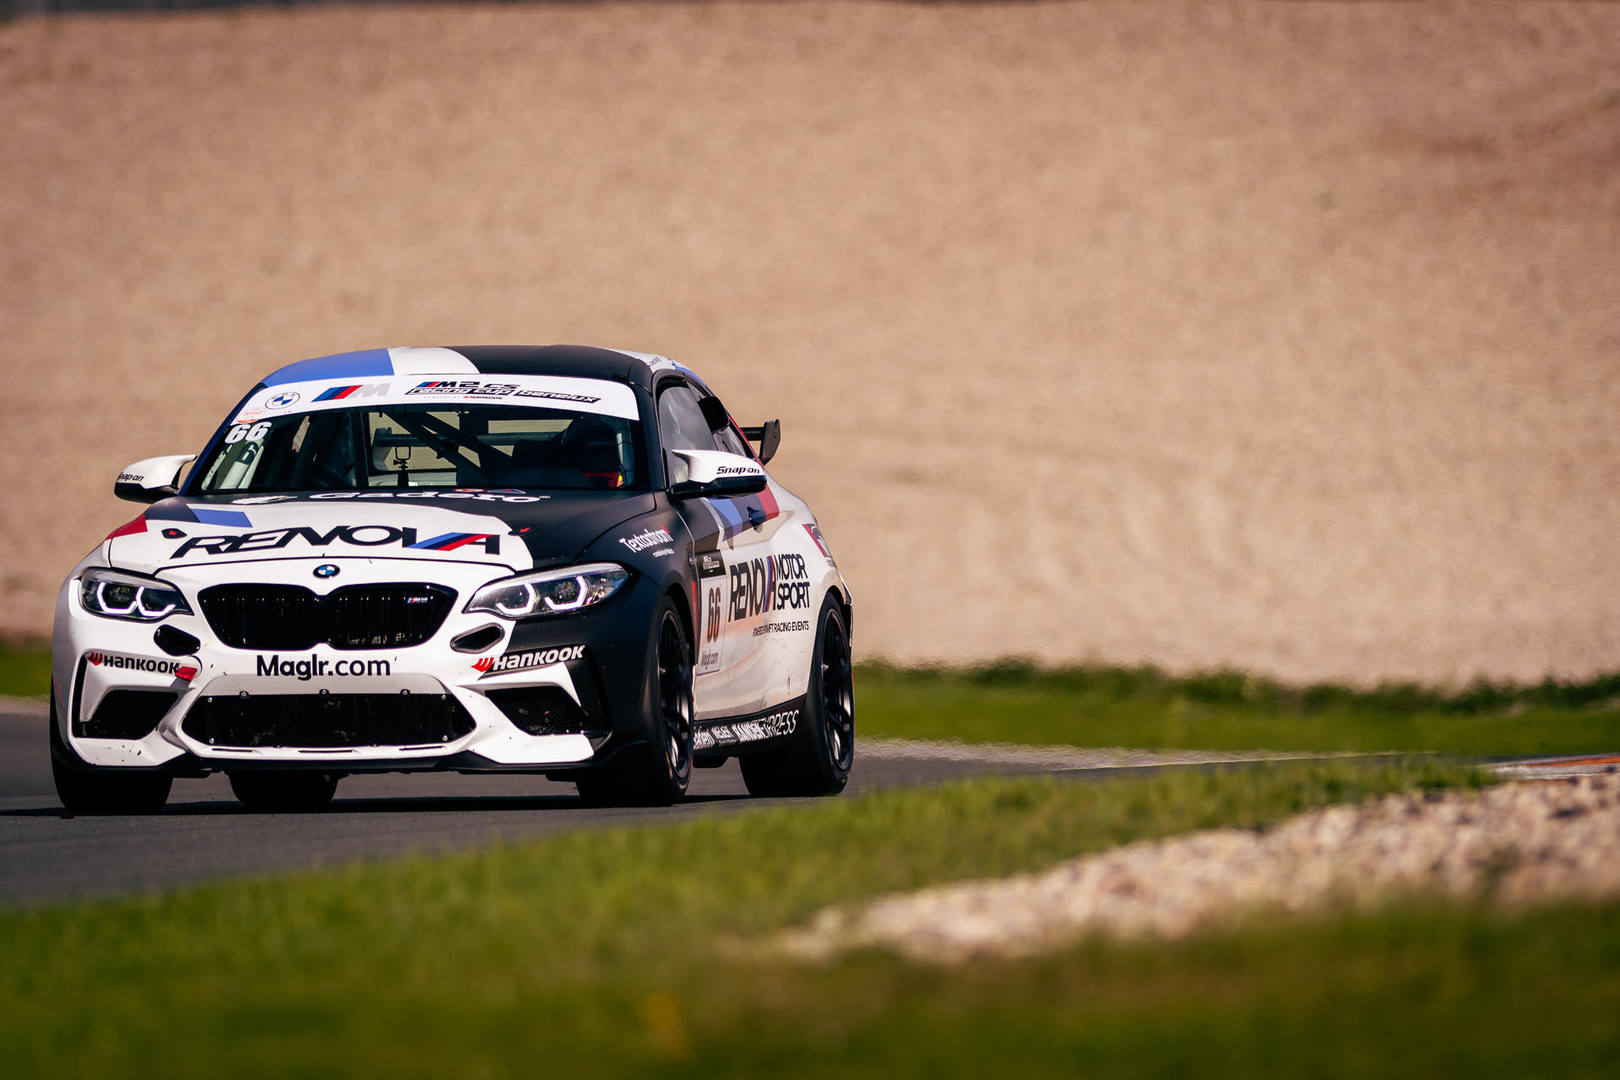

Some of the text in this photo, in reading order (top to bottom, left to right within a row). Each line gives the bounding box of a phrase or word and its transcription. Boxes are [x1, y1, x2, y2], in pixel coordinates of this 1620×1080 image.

[225, 421, 272, 444] 66
[716, 466, 760, 475] Snap-on
[169, 525, 500, 559] RENOVA
[728, 553, 808, 622] RENOVA MOTOR
[777, 582, 810, 611] SPORT
[707, 587, 721, 643] 66
[791, 620, 809, 632] EVENTS
[256, 654, 391, 681] Maglr.com
[492, 645, 586, 671] HANKOOK
